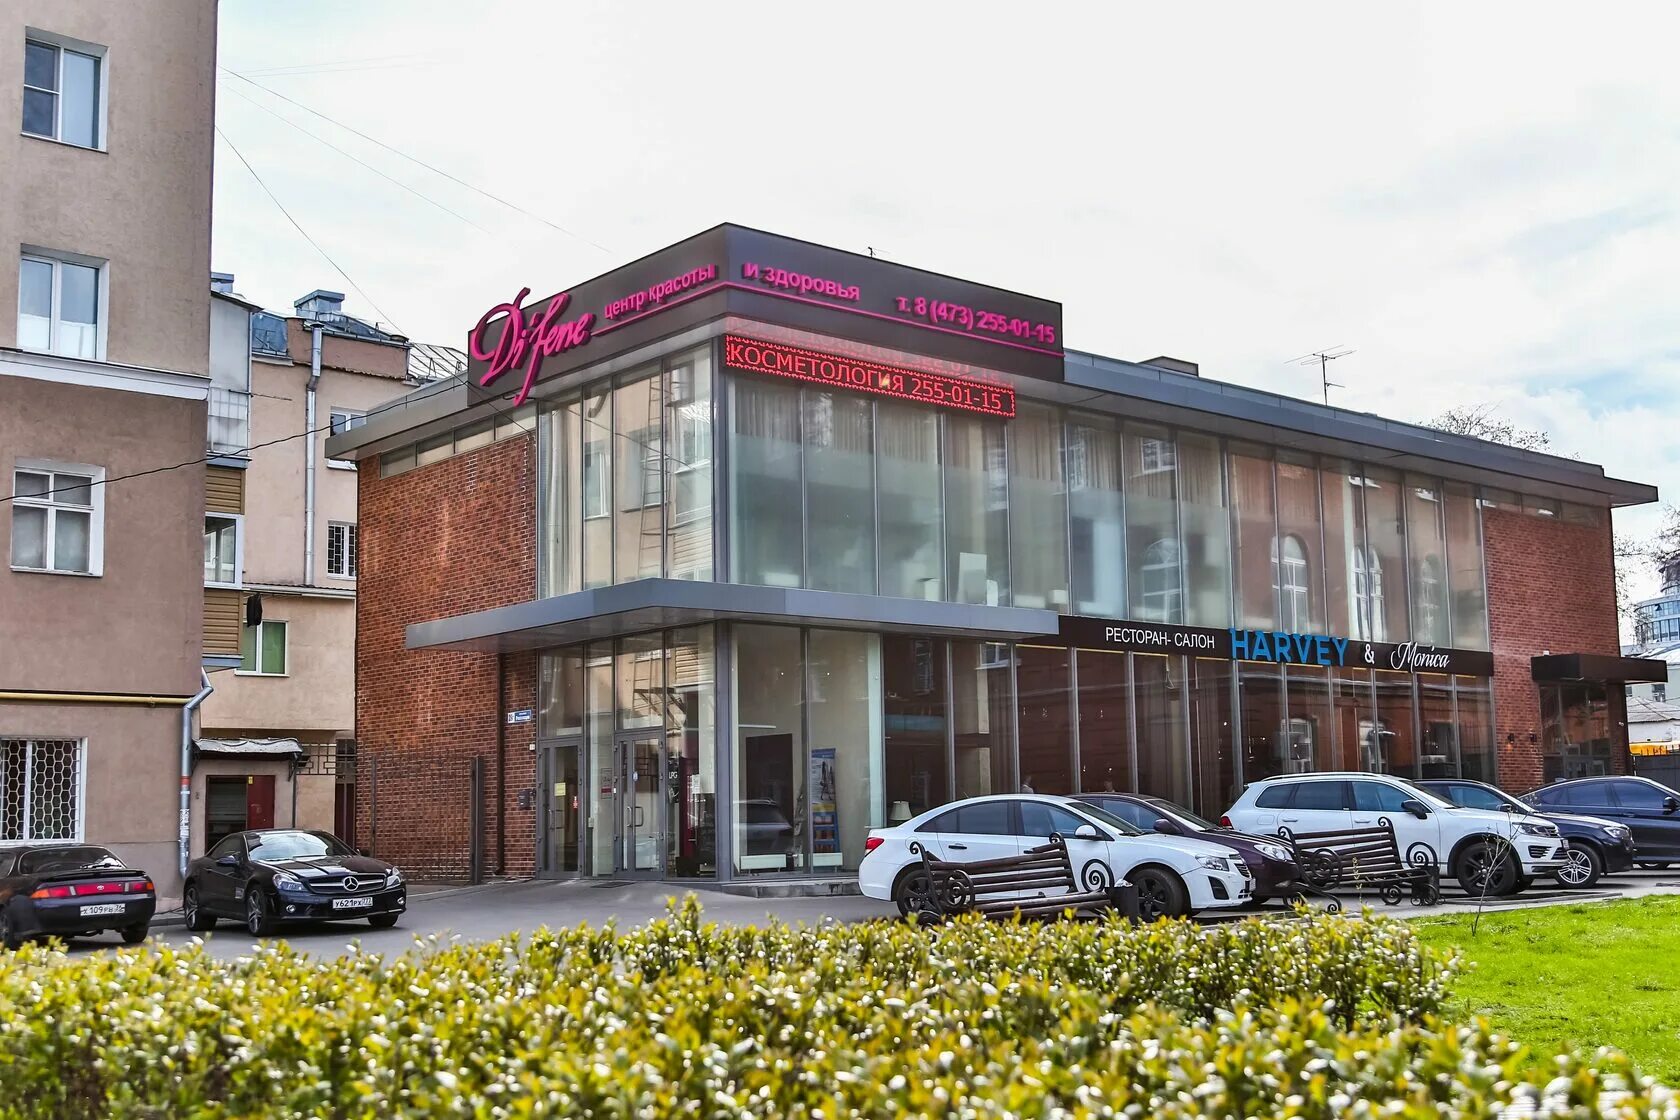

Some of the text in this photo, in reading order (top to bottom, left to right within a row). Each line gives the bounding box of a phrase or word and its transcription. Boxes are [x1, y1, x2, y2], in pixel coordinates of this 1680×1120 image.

[604, 263, 717, 320] центр красоты
[763, 266, 860, 300] здоровья
[914, 296, 927, 316] 8
[929, 299, 974, 331] (473)
[975, 310, 1056, 344] 255-01-15
[729, 343, 1003, 411] КОСМЕТОЛОГИЯ 255-01-15
[1174, 632, 1216, 649] САЛОН
[1228, 627, 1349, 667] HARVEY
[1364, 643, 1376, 665] &
[1390, 640, 1450, 674] Monica
